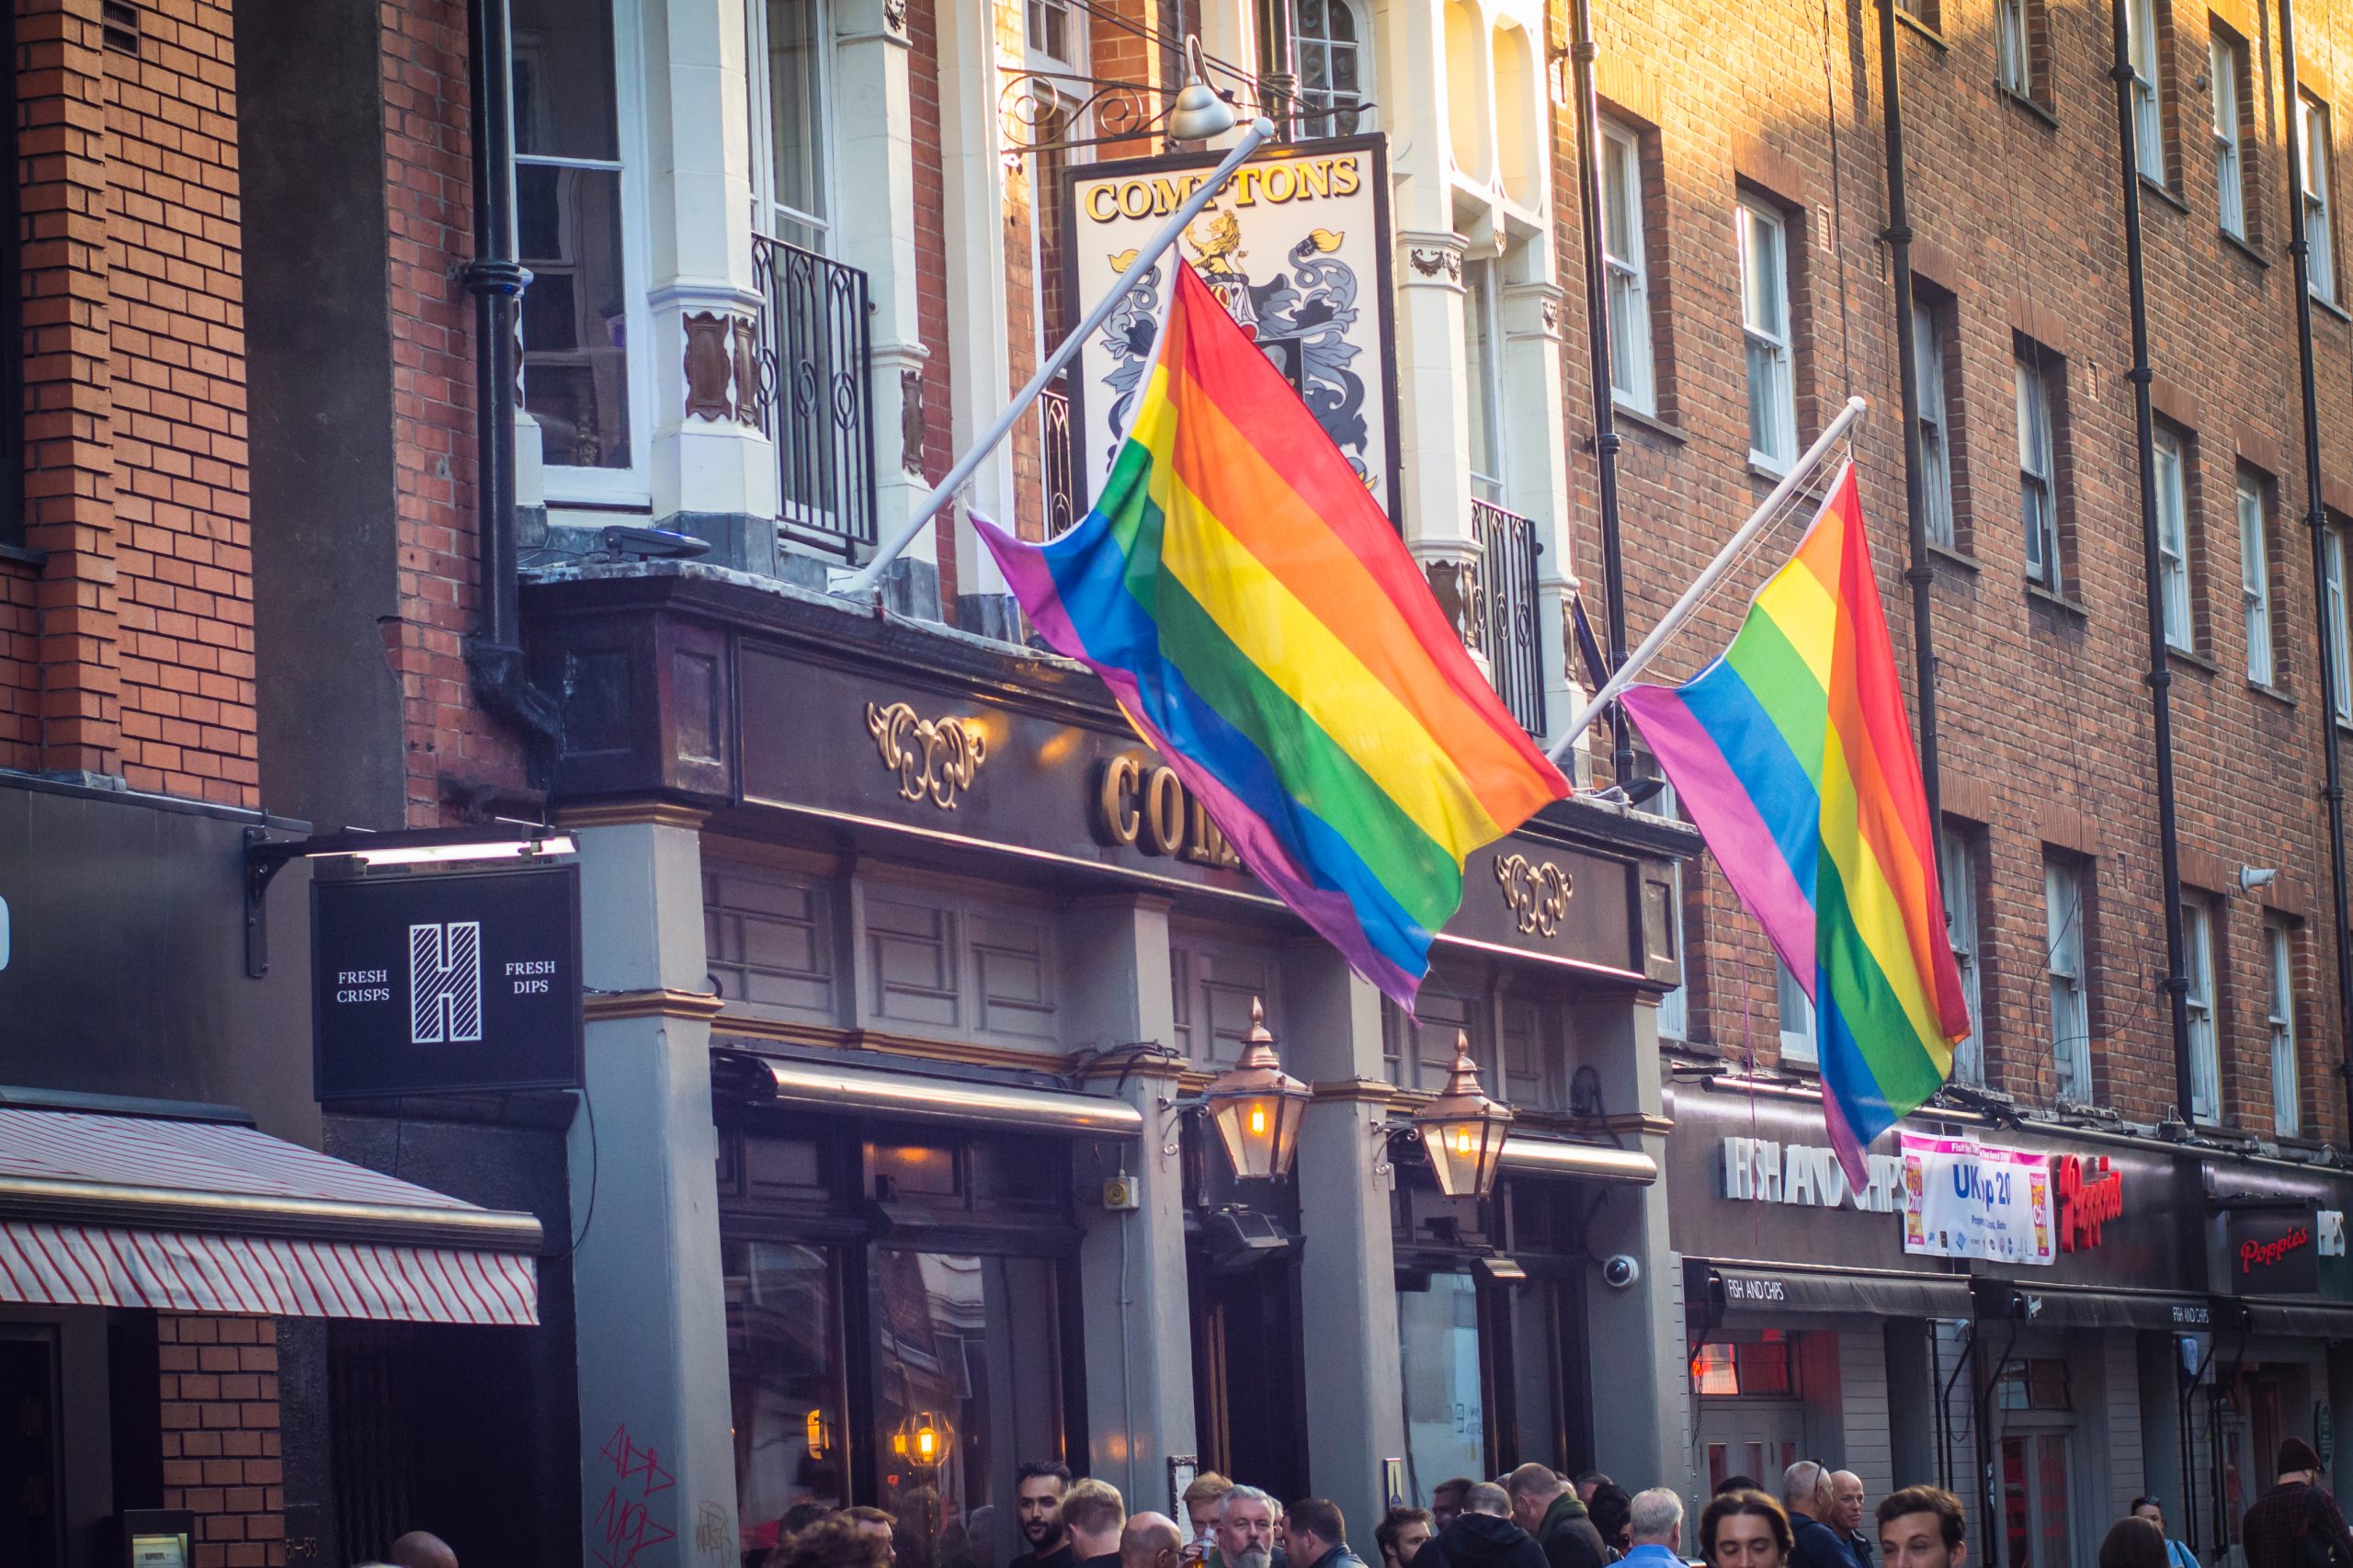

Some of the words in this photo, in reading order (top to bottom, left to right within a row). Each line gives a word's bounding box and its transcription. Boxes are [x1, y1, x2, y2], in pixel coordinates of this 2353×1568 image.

[337, 970, 388, 984] FRESH
[505, 960, 556, 976] FRESH
[409, 921, 482, 1044] H
[514, 980, 549, 994] DIPS
[336, 988, 390, 1003] CRISPS
[1724, 1136, 1782, 1202] FISH
[1784, 1144, 1844, 1207] AND
[1952, 1164, 1981, 1199] UK
[1995, 1171, 2011, 1205] 20
[2240, 1227, 2308, 1275] Poppies
[1727, 1278, 1745, 1299] FISH
[1746, 1280, 1764, 1300] AND
[1764, 1280, 1784, 1301] CHIPS
[2184, 1307, 2195, 1323] AND
